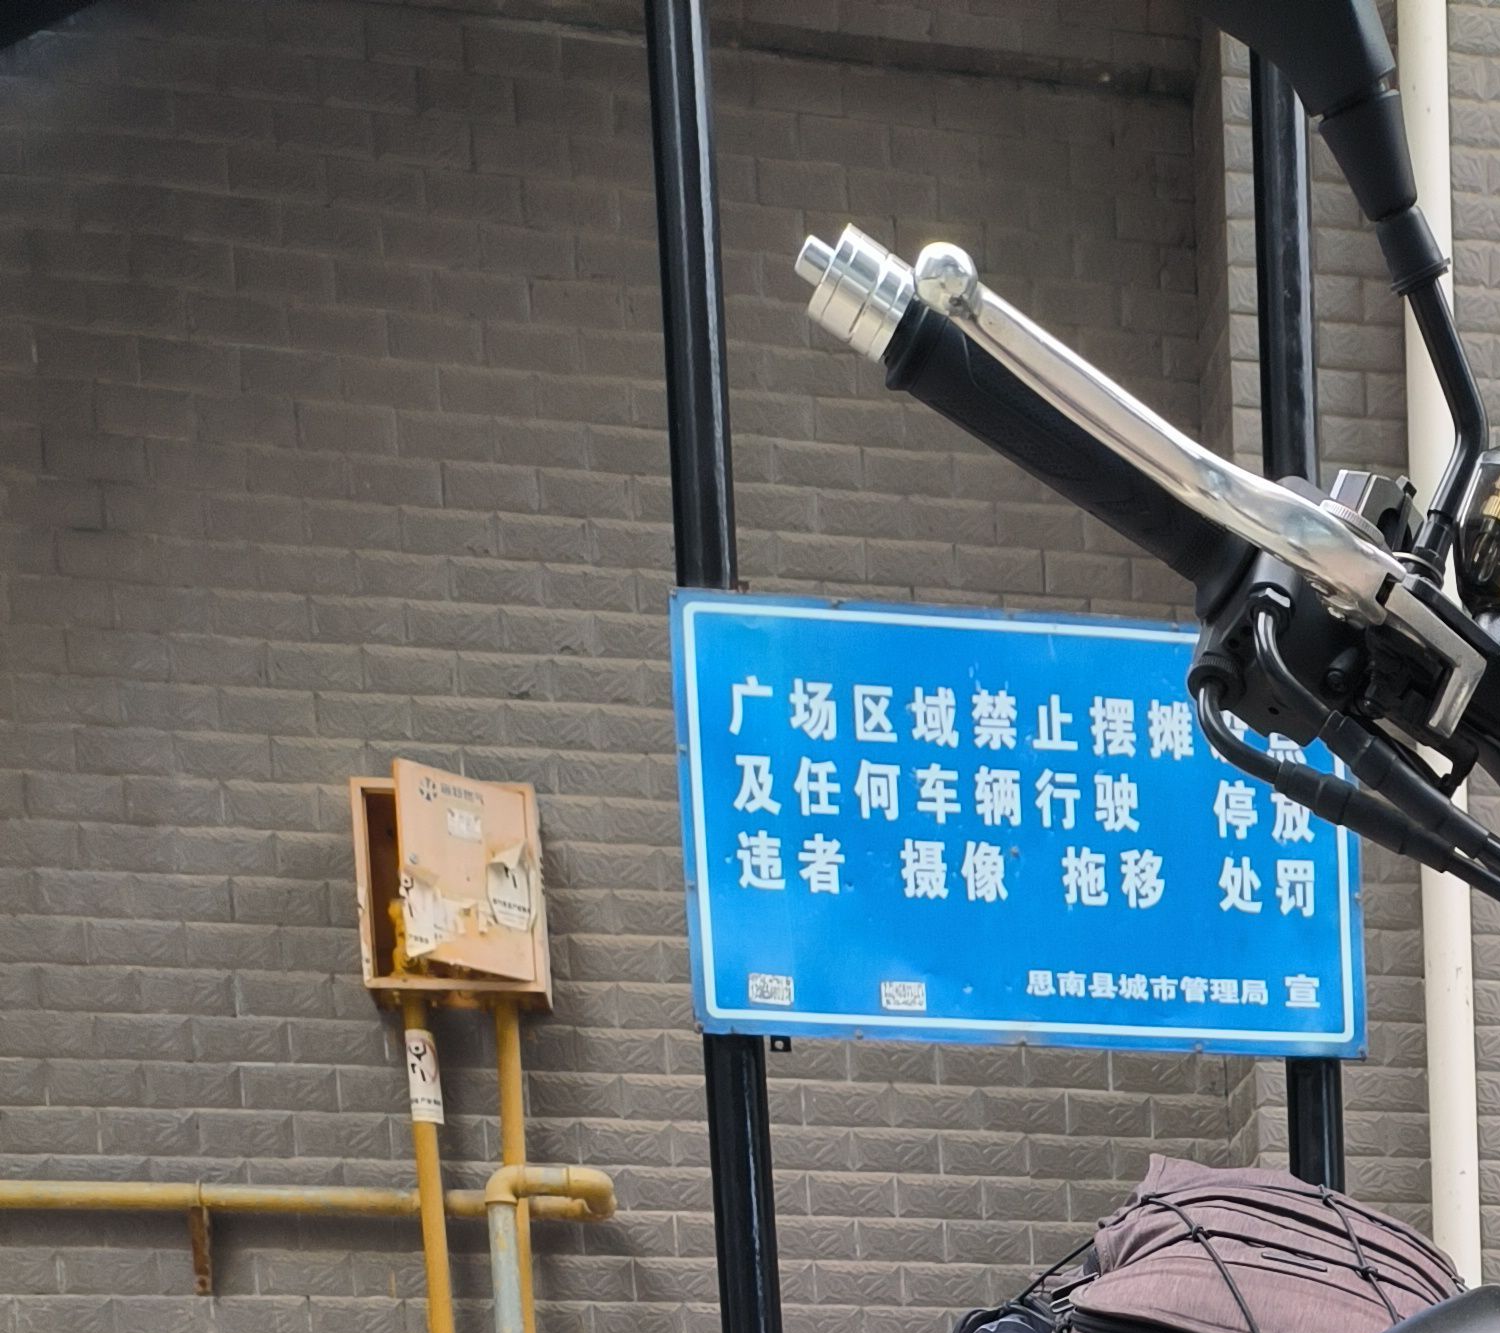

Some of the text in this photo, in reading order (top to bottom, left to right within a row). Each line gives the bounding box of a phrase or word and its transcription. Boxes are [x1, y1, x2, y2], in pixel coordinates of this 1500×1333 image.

[730, 677, 1308, 766] 广场区域禁止摆摊
[734, 756, 1316, 844] 及任何车辆行驶 停放
[737, 831, 1315, 917] 违者 摄像 拖移 处罚
[1027, 970, 1320, 1008] 思南县城市管理局 宣
